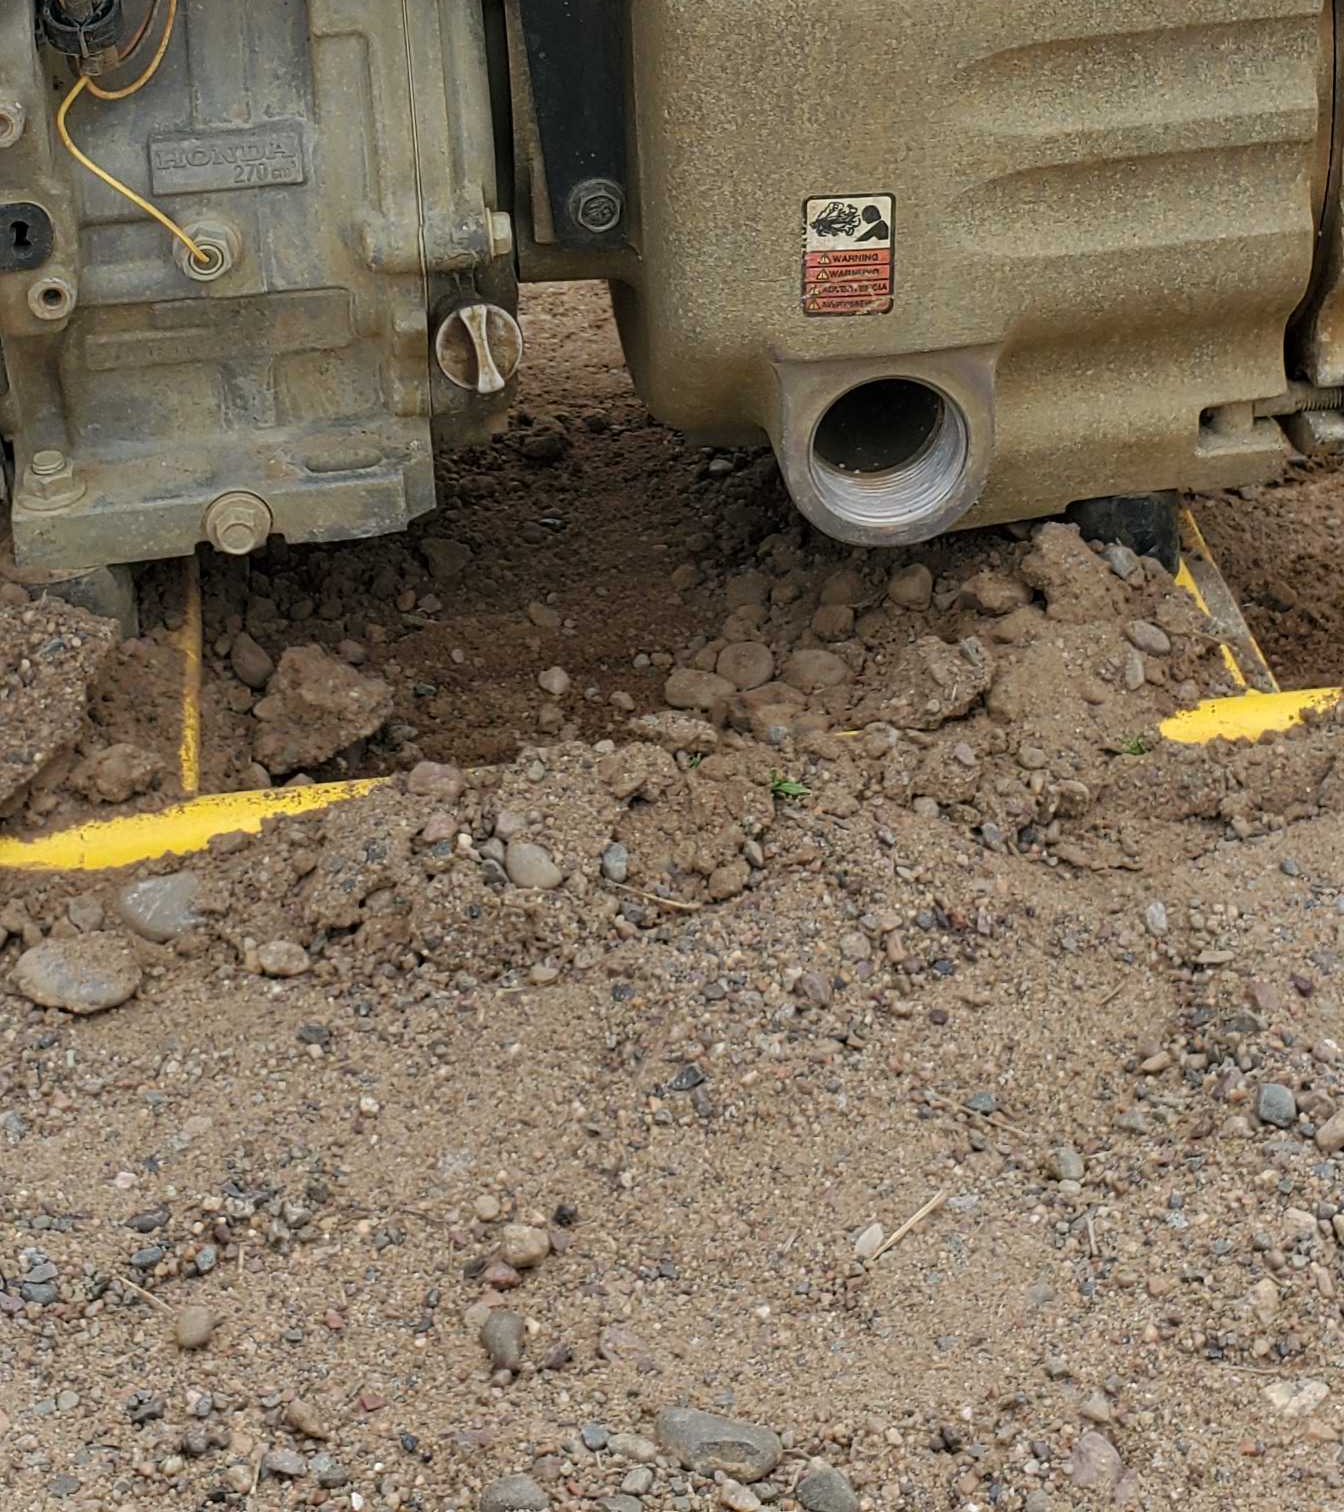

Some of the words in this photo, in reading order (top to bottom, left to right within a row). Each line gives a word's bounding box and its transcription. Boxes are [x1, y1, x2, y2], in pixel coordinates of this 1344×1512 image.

[156, 141, 297, 170] HONDA
[233, 162, 269, 184] 270
[832, 253, 880, 263] WARNING
